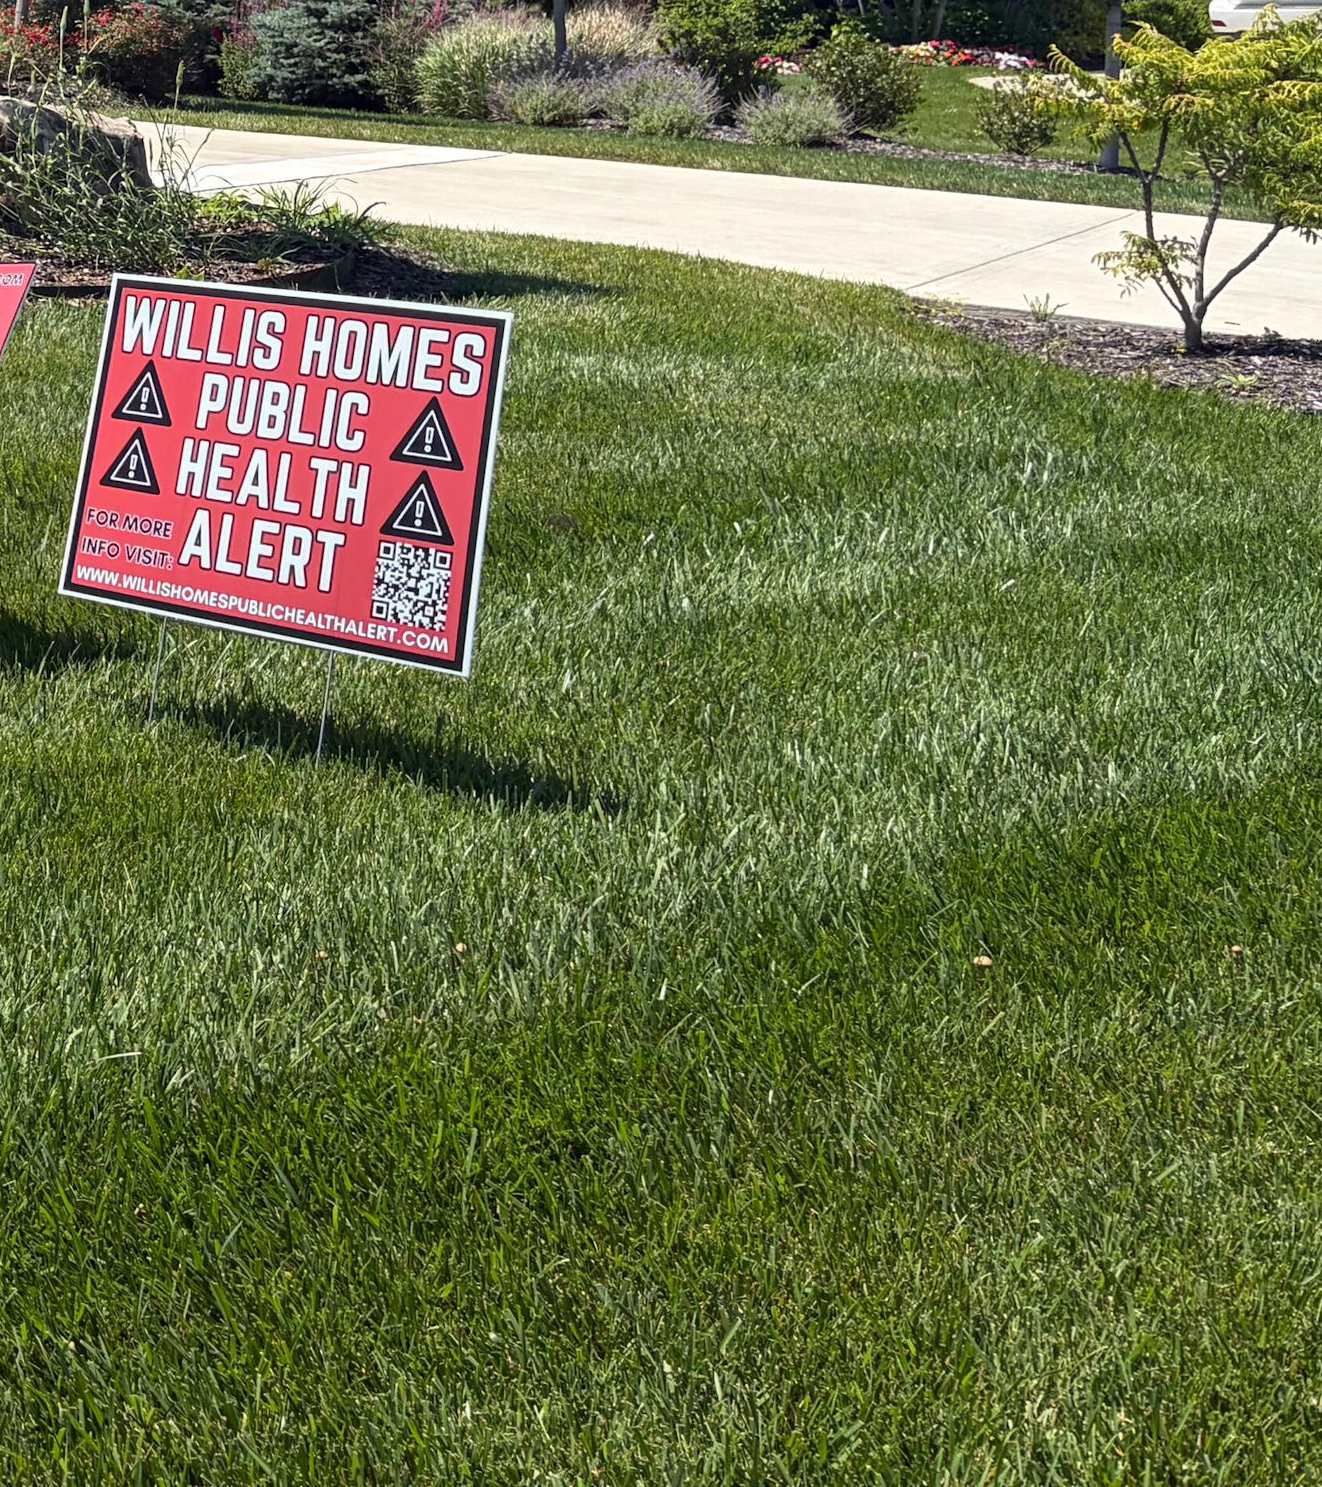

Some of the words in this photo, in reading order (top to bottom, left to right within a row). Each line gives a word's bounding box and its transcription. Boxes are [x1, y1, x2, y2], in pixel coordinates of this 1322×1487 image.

[120, 295, 287, 371] WILLIS
[300, 314, 488, 397] HOMES
[195, 372, 370, 452] PUBLIC
[86, 508, 119, 529] FOR
[122, 515, 173, 538] MORE
[175, 437, 372, 526] HEALTH
[81, 537, 120, 559] INFO
[125, 545, 174, 570] VISIT:
[178, 509, 347, 595] ALERT
[76, 564, 450, 654] WWW.WILLISHOMESPUBLICHEALTHALERT.COM
